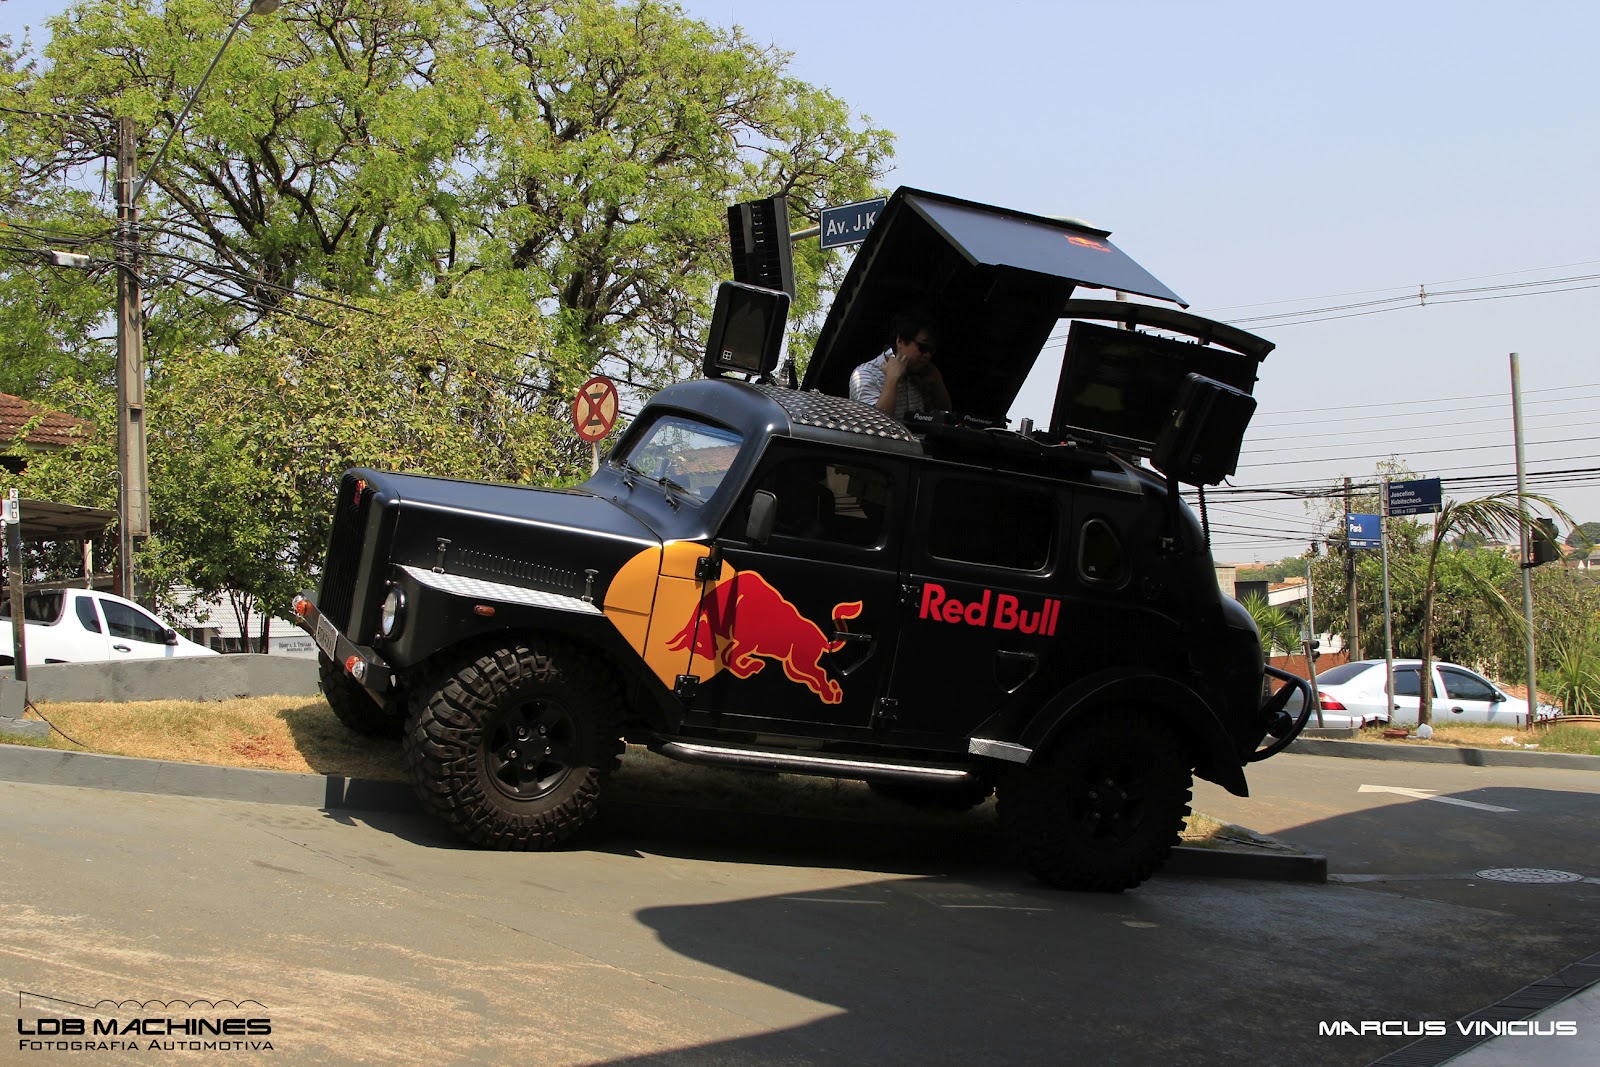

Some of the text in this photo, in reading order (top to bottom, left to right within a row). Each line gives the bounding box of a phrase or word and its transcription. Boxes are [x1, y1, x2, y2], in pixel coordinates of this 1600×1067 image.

[826, 219, 849, 237] Av.
[913, 412, 934, 422] Pioneer
[963, 414, 993, 425] Pioneer
[1350, 524, 1362, 532] Pará
[919, 583, 1061, 637] Red Bull
